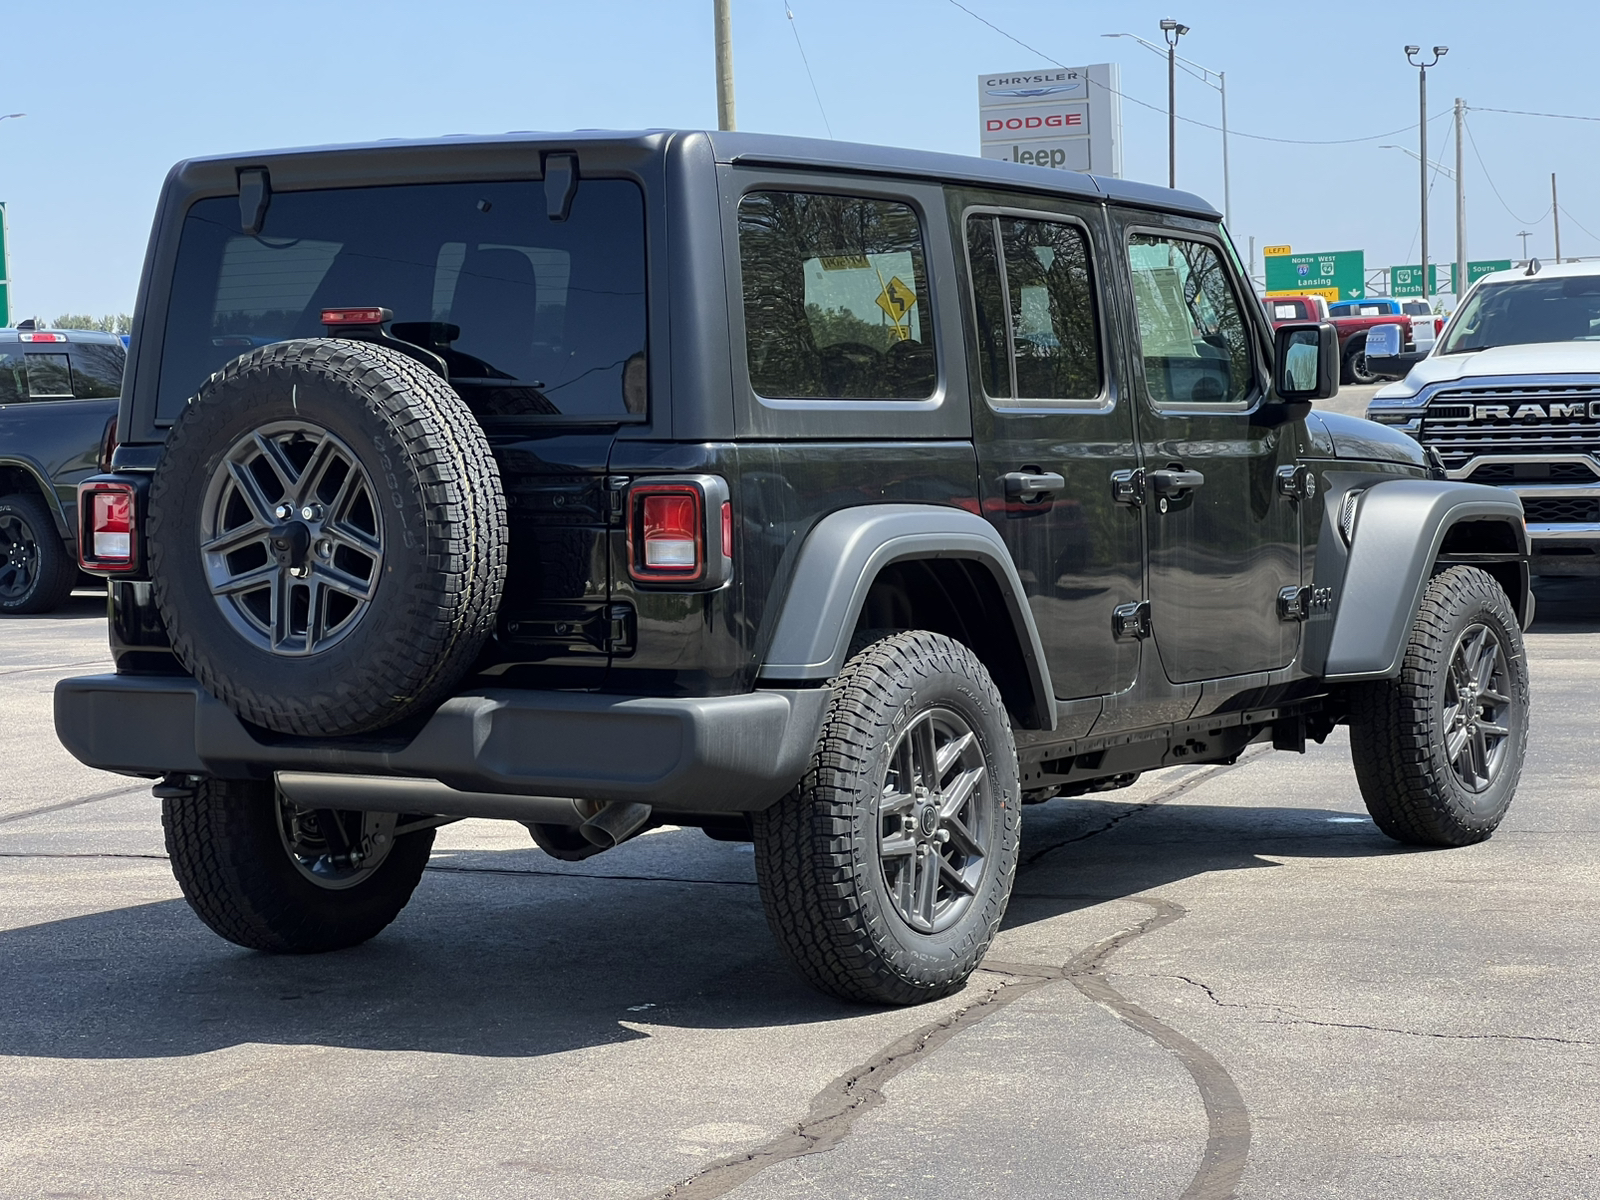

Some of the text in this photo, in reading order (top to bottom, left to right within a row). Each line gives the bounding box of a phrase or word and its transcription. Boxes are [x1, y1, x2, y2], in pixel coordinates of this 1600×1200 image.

[986, 73, 1078, 87] CHRYSLER
[986, 113, 1082, 132] DODGE
[1002, 145, 1066, 169] Jeep
[1472, 265, 1495, 273] SOUTH
[1297, 277, 1332, 286] Lansing
[1475, 403, 1585, 418] RAM
[1308, 583, 1333, 609] Jeep
